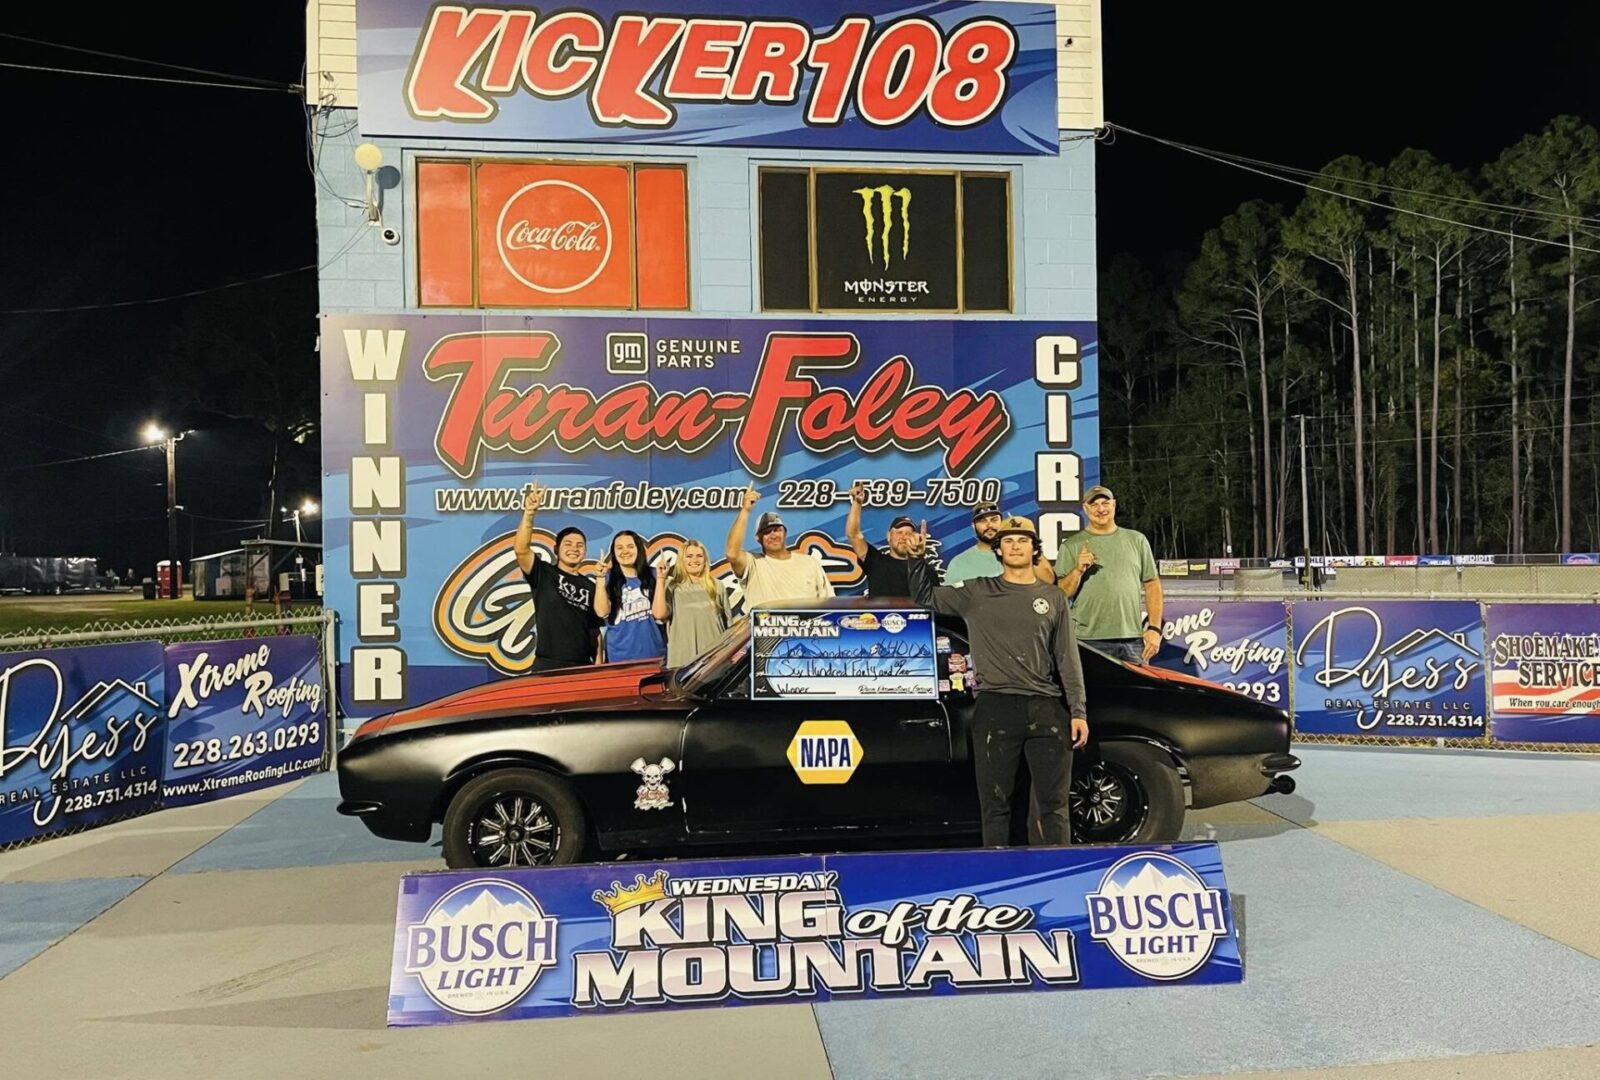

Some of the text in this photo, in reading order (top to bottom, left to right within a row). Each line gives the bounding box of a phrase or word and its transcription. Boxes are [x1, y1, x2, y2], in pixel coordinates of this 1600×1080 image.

[408, 5, 1018, 128] KICKER 108
[844, 278, 930, 295] MONSTER
[613, 342, 642, 364] gm
[656, 339, 741, 353] GENUINE
[656, 355, 715, 368] PARTS
[422, 330, 1011, 479] Turan-Foley
[777, 479, 1002, 507] 228-539-7500
[343, 329, 406, 701] WINNER
[1297, 556, 1323, 564] MHLE
[754, 626, 839, 637] MOUNTAIN
[760, 616, 799, 626] KING
[800, 619, 812, 628] of
[813, 618, 832, 626] the
[1183, 630, 1285, 674] Roofing
[168, 644, 270, 718] Xtreme
[806, 659, 848, 677] Hundred
[1296, 606, 1479, 730] Dyess
[1518, 662, 1600, 687] SERVICE
[241, 670, 321, 718] Roofing
[1325, 699, 1471, 710] REAL ESTATE LLC
[1509, 697, 1533, 707] When
[1535, 700, 1550, 709] you
[1386, 713, 1484, 727] 228.731.4314
[173, 722, 320, 768] 228.263.0293
[800, 738, 852, 768] NAPA
[0, 766, 148, 804] REAL ESTATE LLC
[163, 757, 321, 796] www.XtremeRoofingLLC.com
[64, 779, 158, 813] 228.731.4314
[671, 872, 836, 896] WEDNESDAY
[612, 889, 1028, 949] KING of the
[1088, 892, 1223, 935] BUSCH
[408, 919, 556, 969] BUSCH
[1125, 935, 1199, 955] LIGHT
[437, 966, 524, 990] LIGHT
[573, 930, 1075, 1004] MOUNTAIN
